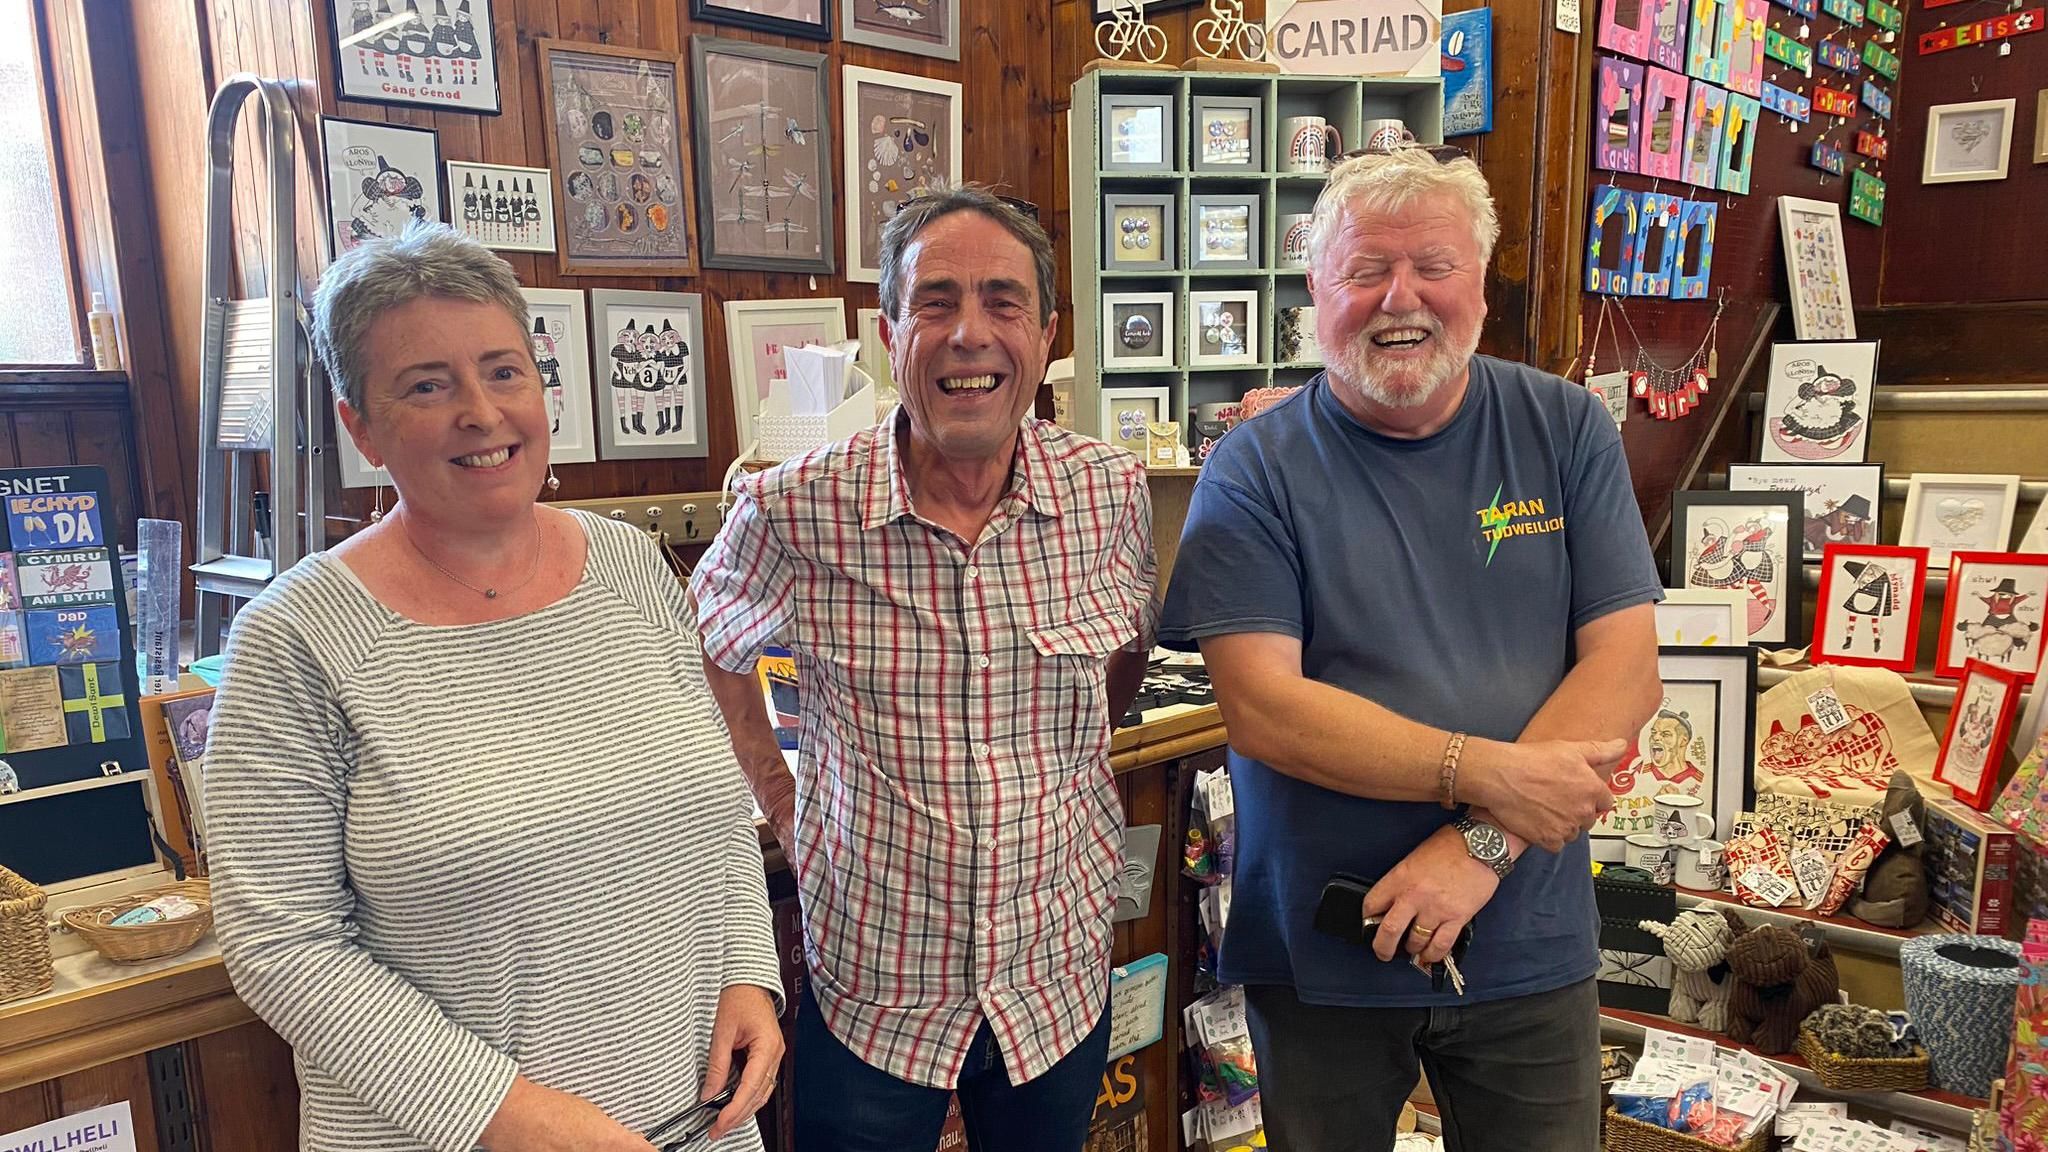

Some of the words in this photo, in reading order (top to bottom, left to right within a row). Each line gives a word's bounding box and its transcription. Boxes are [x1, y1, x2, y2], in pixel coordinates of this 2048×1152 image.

[1277, 14, 1428, 59] CARIAD
[1957, 21, 2008, 46] Elis
[1653, 35, 1682, 70] Tesni
[382, 82, 416, 97] Gang
[420, 84, 461, 100] Genod
[1602, 143, 1635, 171] Carys
[1591, 267, 1628, 294] Dylan
[643, 368, 653, 384] a
[11, 495, 96, 514] IECHYD
[1476, 498, 1545, 525] TARAN
[53, 511, 95, 544] DA
[27, 552, 101, 564] CYMRU
[32, 595, 57, 605] AM
[63, 591, 106, 603] BYTH
[4, 1120, 118, 1152] WLLHELI
